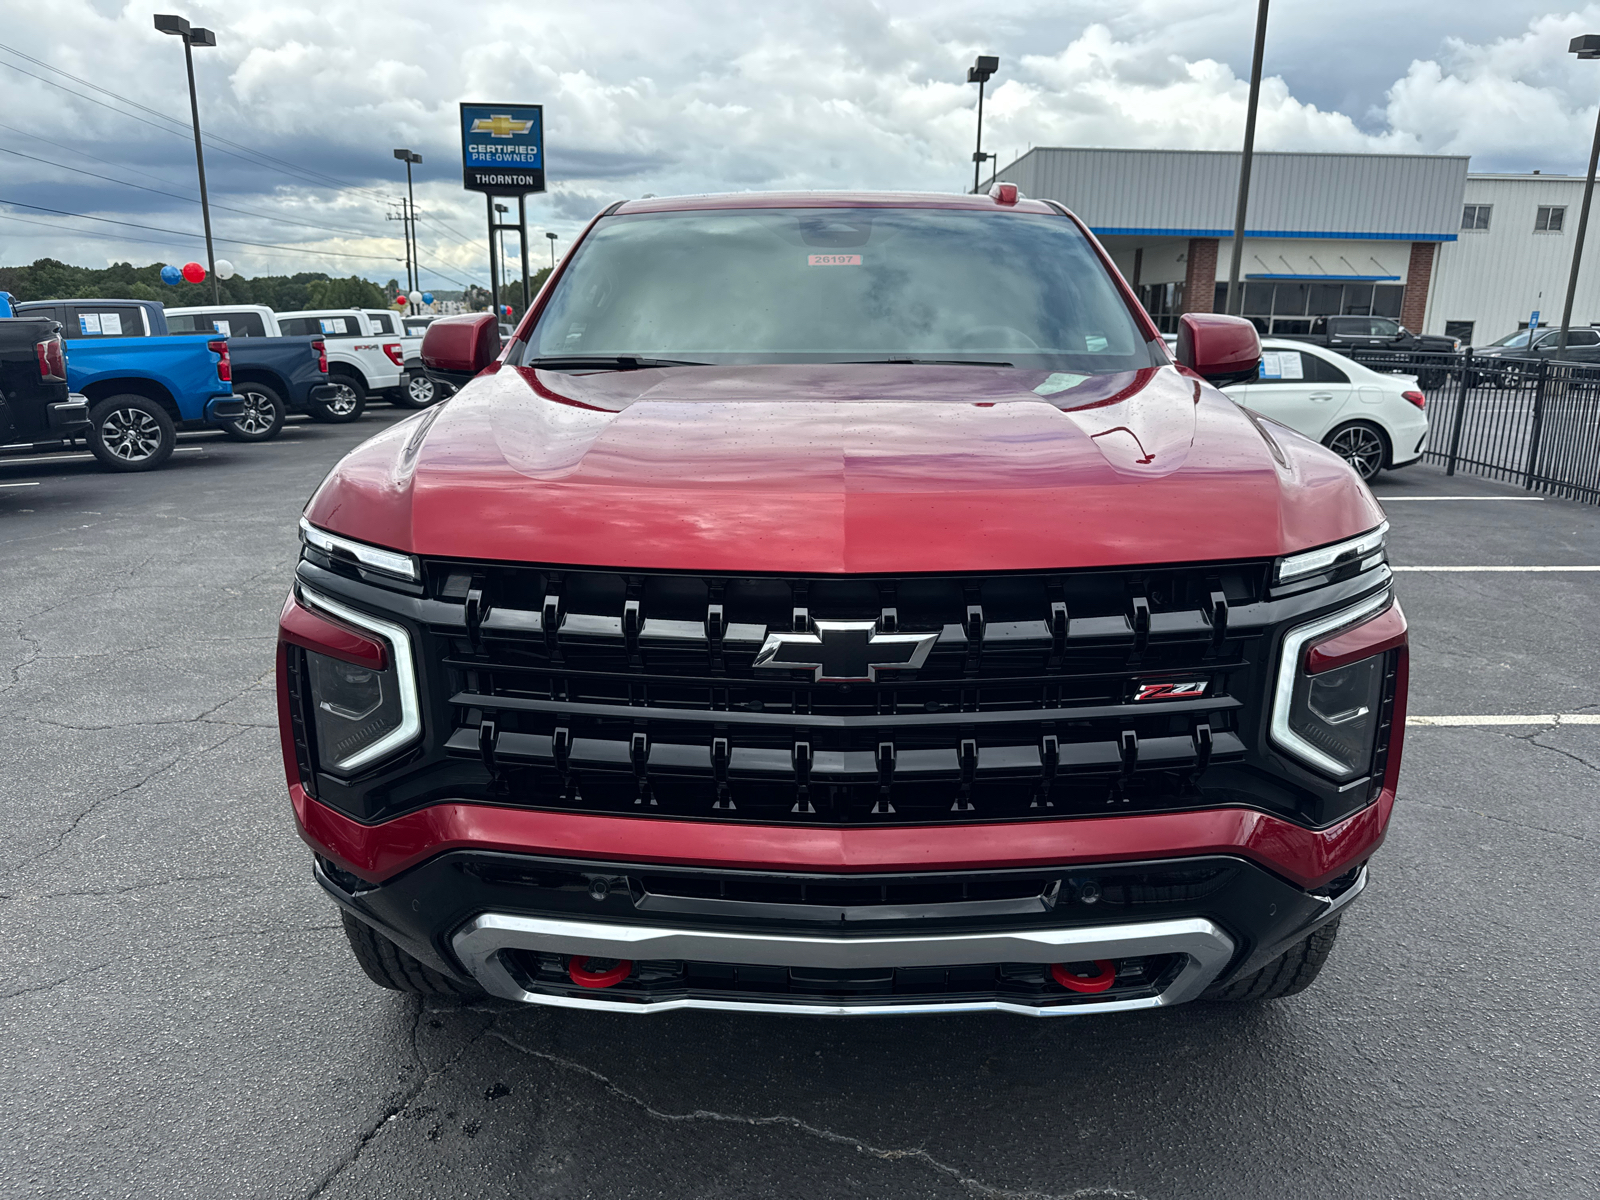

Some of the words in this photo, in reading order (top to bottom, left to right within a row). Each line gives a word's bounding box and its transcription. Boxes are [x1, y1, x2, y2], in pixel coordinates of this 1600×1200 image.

[468, 144, 537, 154] CERTIFIED
[472, 153, 534, 162] PRE-OWNED
[475, 174, 533, 185] THORNTON
[1134, 682, 1208, 700] Z71
